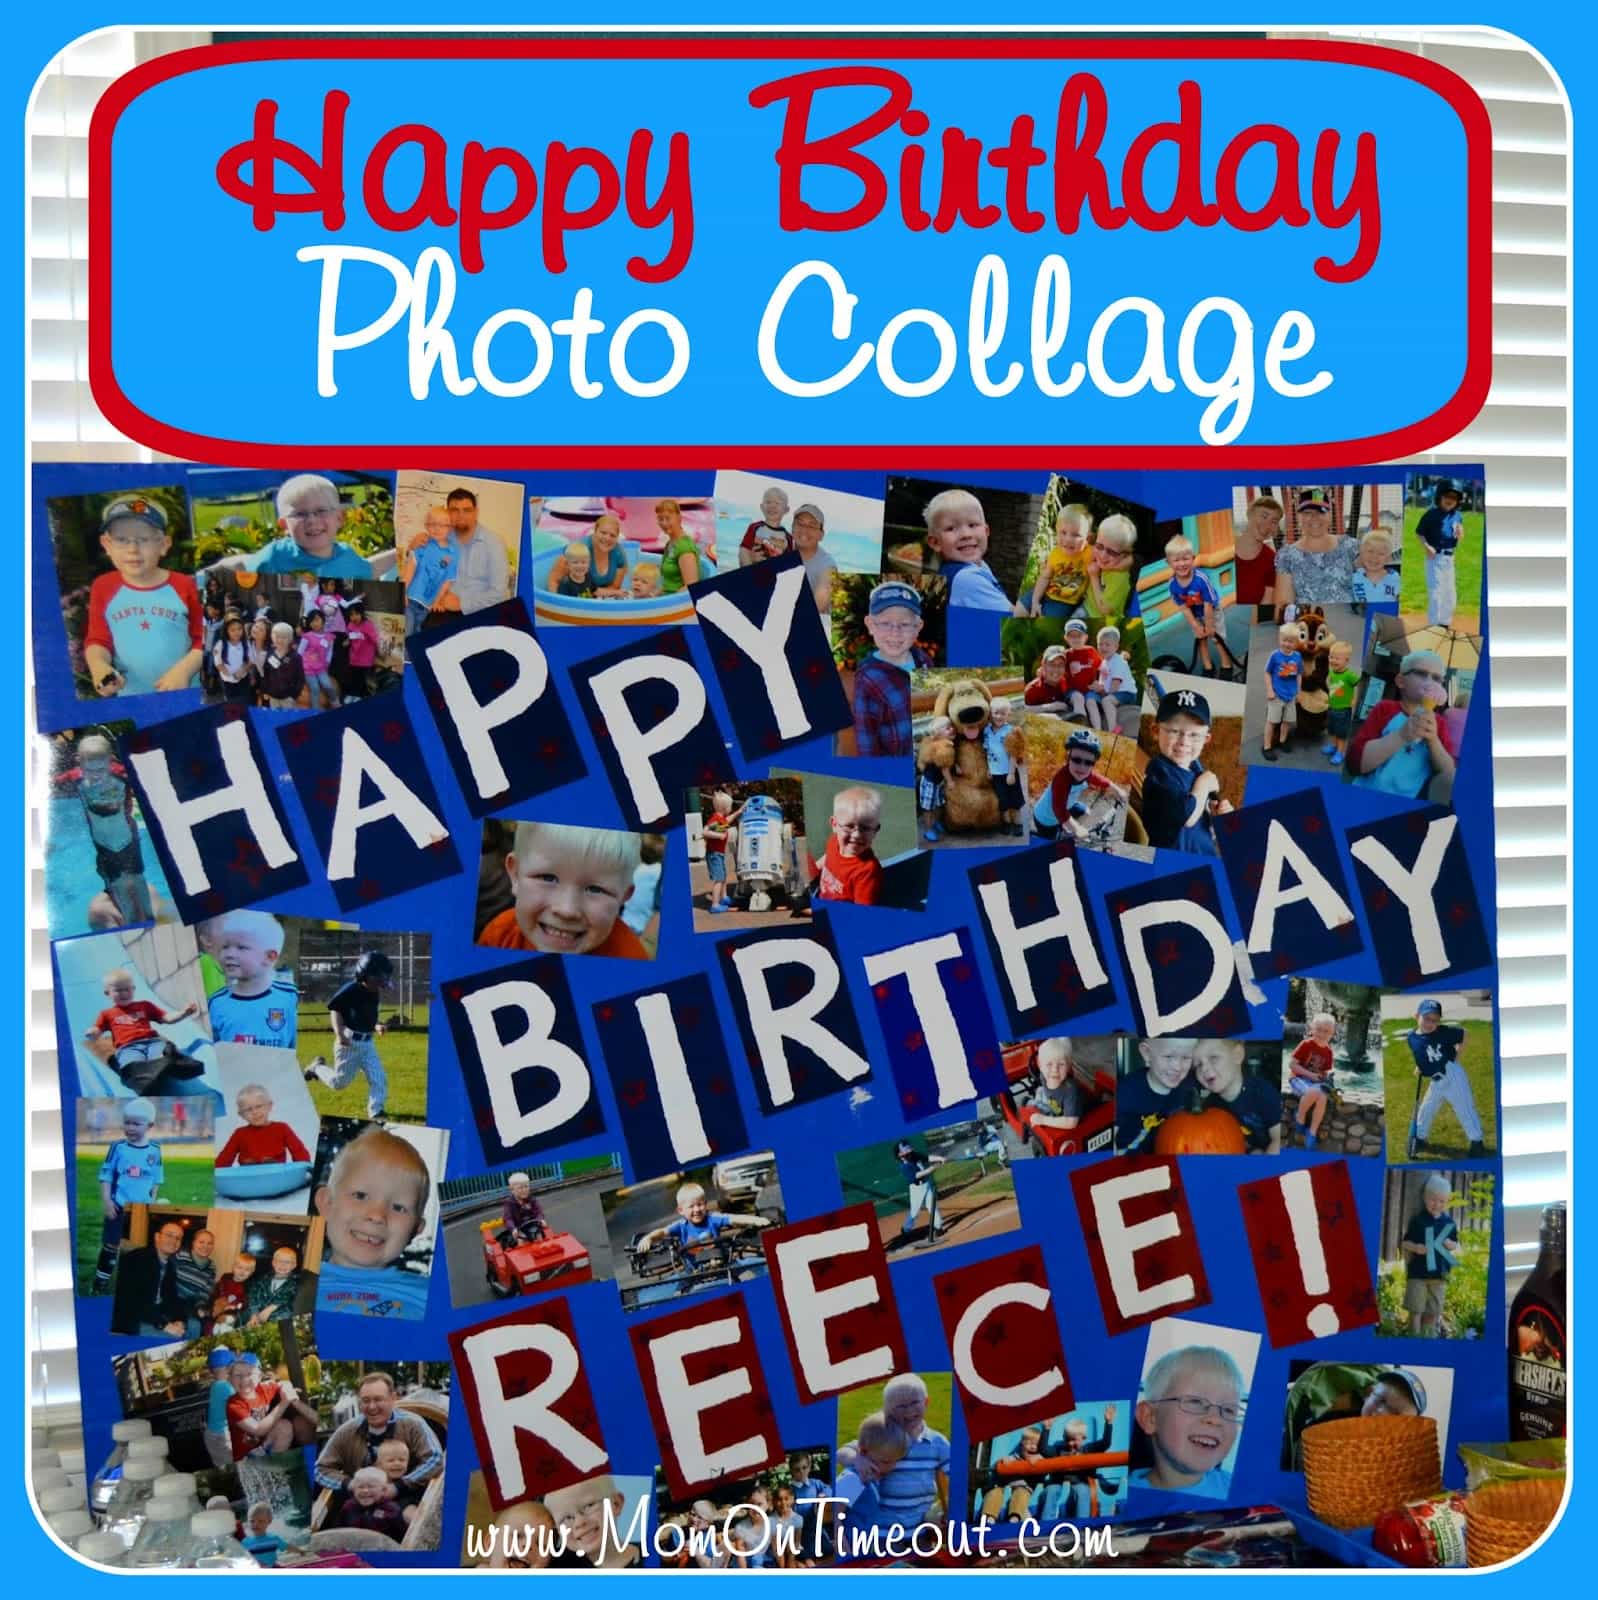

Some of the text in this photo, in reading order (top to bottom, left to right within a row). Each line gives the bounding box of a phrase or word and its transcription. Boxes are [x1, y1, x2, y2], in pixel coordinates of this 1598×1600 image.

[129, 564, 812, 896] HAPPY
[460, 814, 1457, 1164] BIRTHDAY
[462, 1165, 1340, 1501] REECE!
